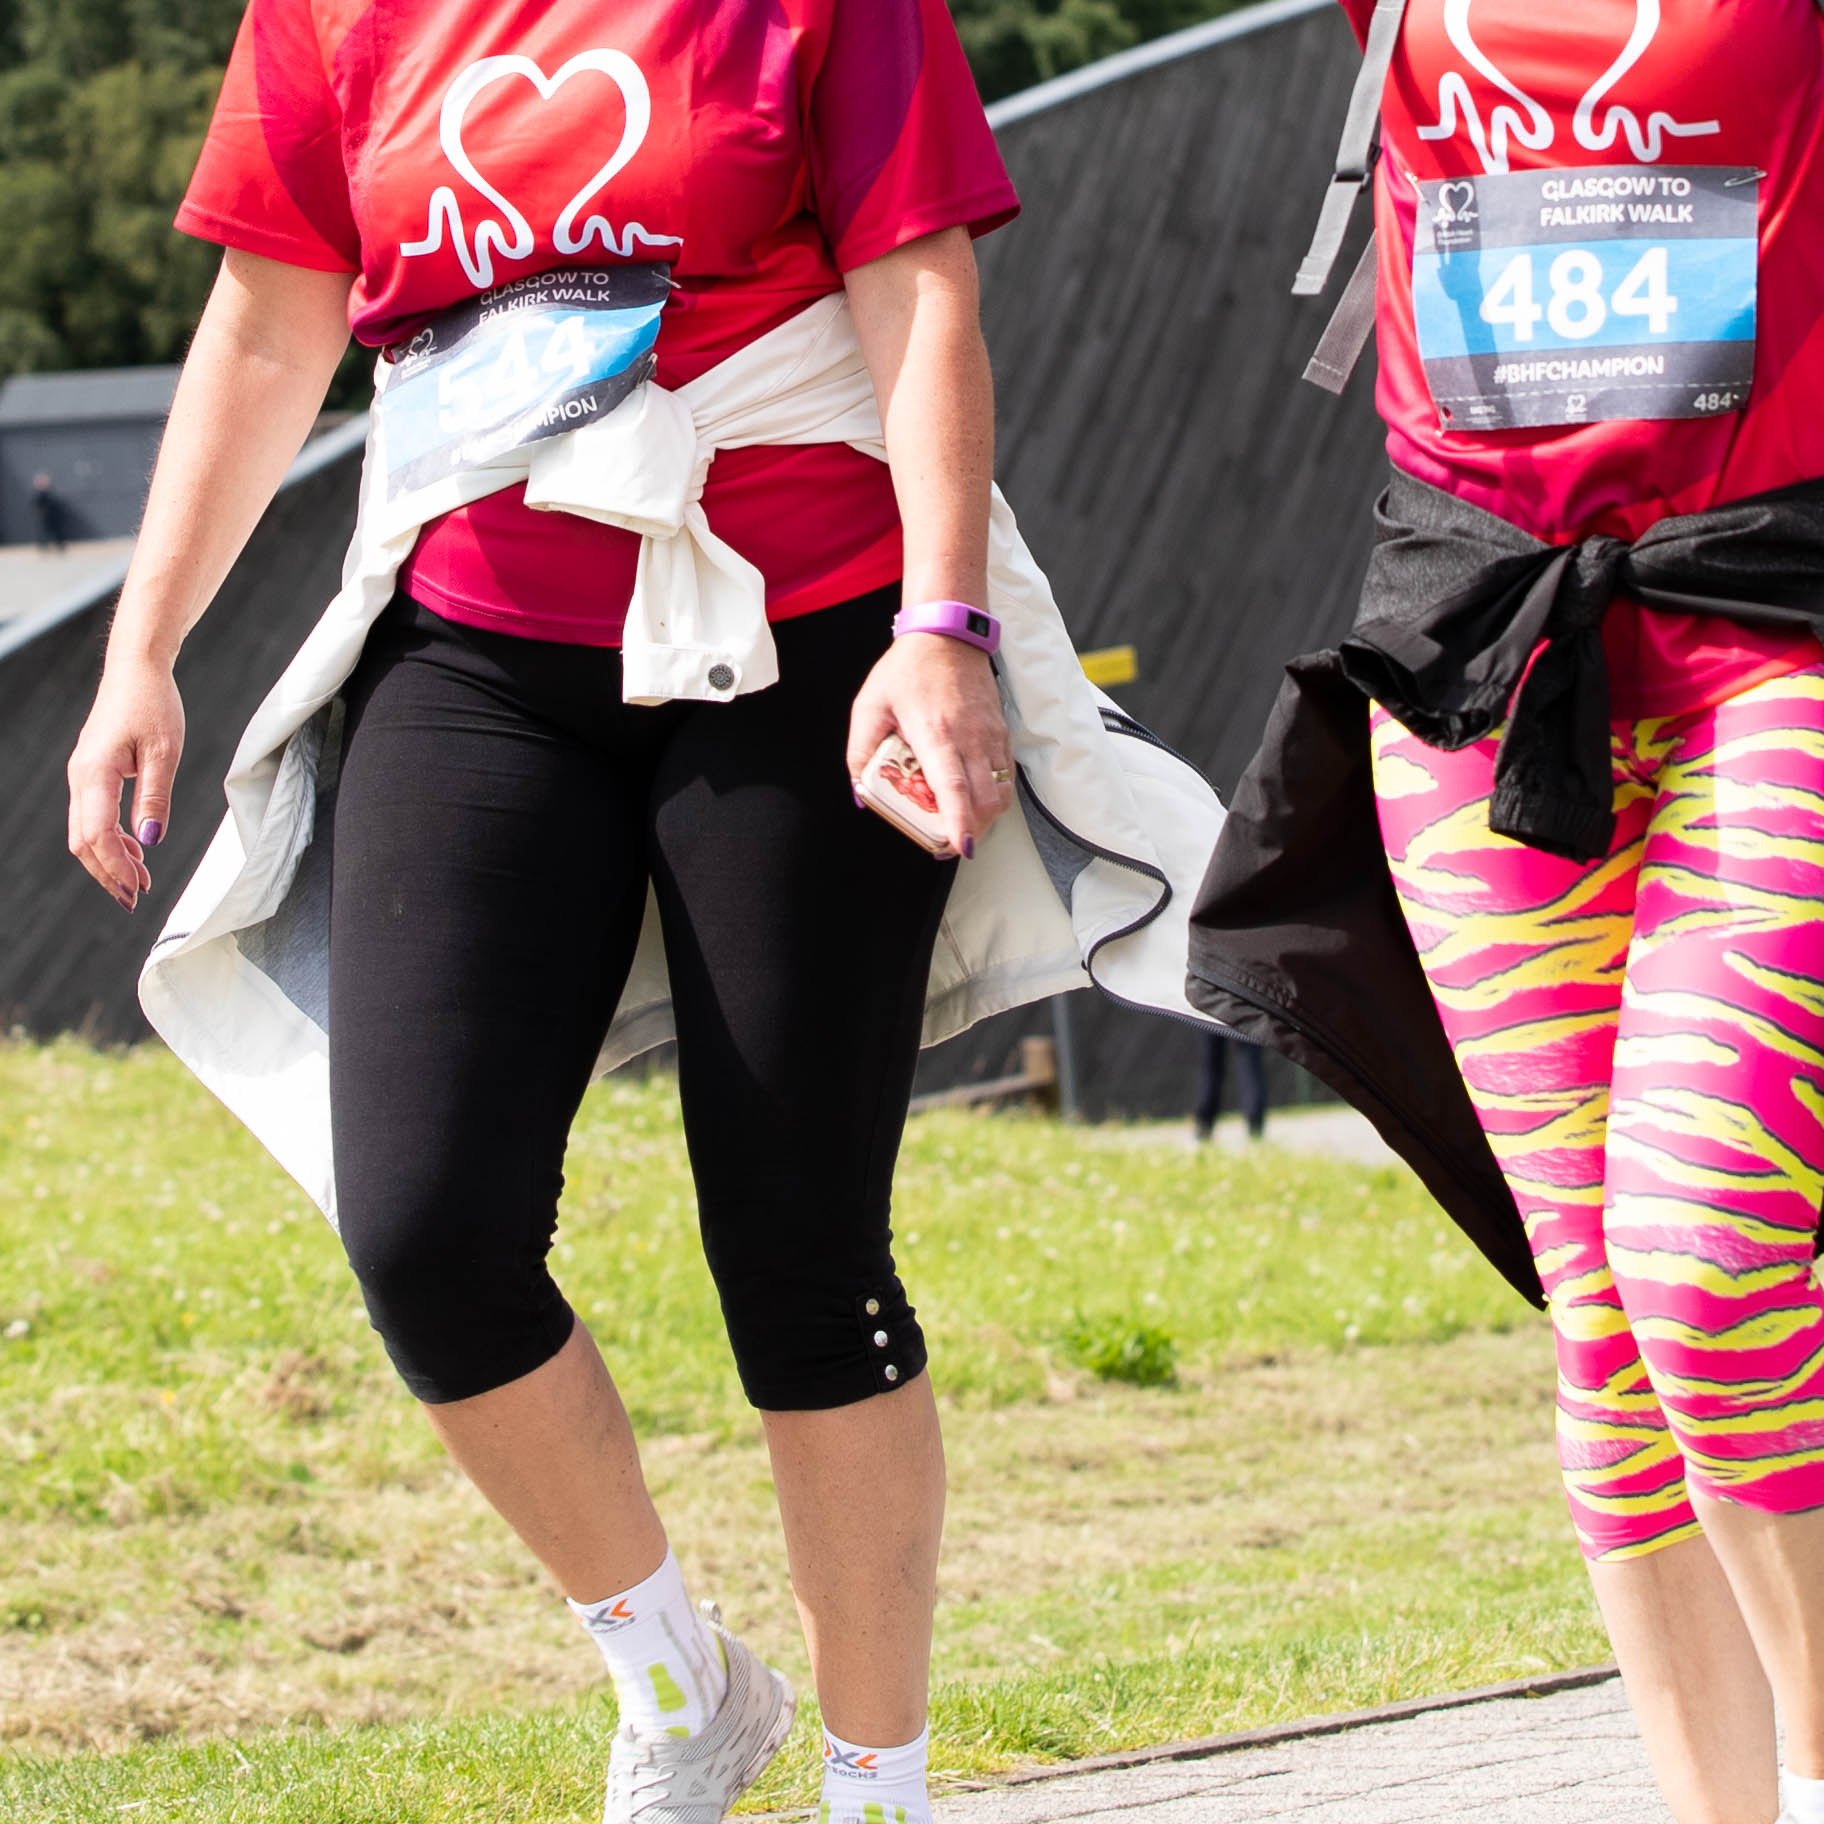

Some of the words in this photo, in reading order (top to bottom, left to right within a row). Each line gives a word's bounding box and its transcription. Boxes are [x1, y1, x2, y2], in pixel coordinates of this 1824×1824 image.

[1541, 176, 1655, 201] GLASGOW
[1659, 176, 1691, 196] TO
[1539, 204, 1625, 226] FALKIRK
[1628, 203, 1694, 223] WALK
[480, 271, 578, 305] GLASGOW
[581, 272, 610, 285] TO
[1479, 246, 1678, 343] 484
[479, 289, 549, 325] FALKIRK
[552, 288, 610, 302] WALK
[1493, 355, 1665, 384] #BHFCHAMPION
